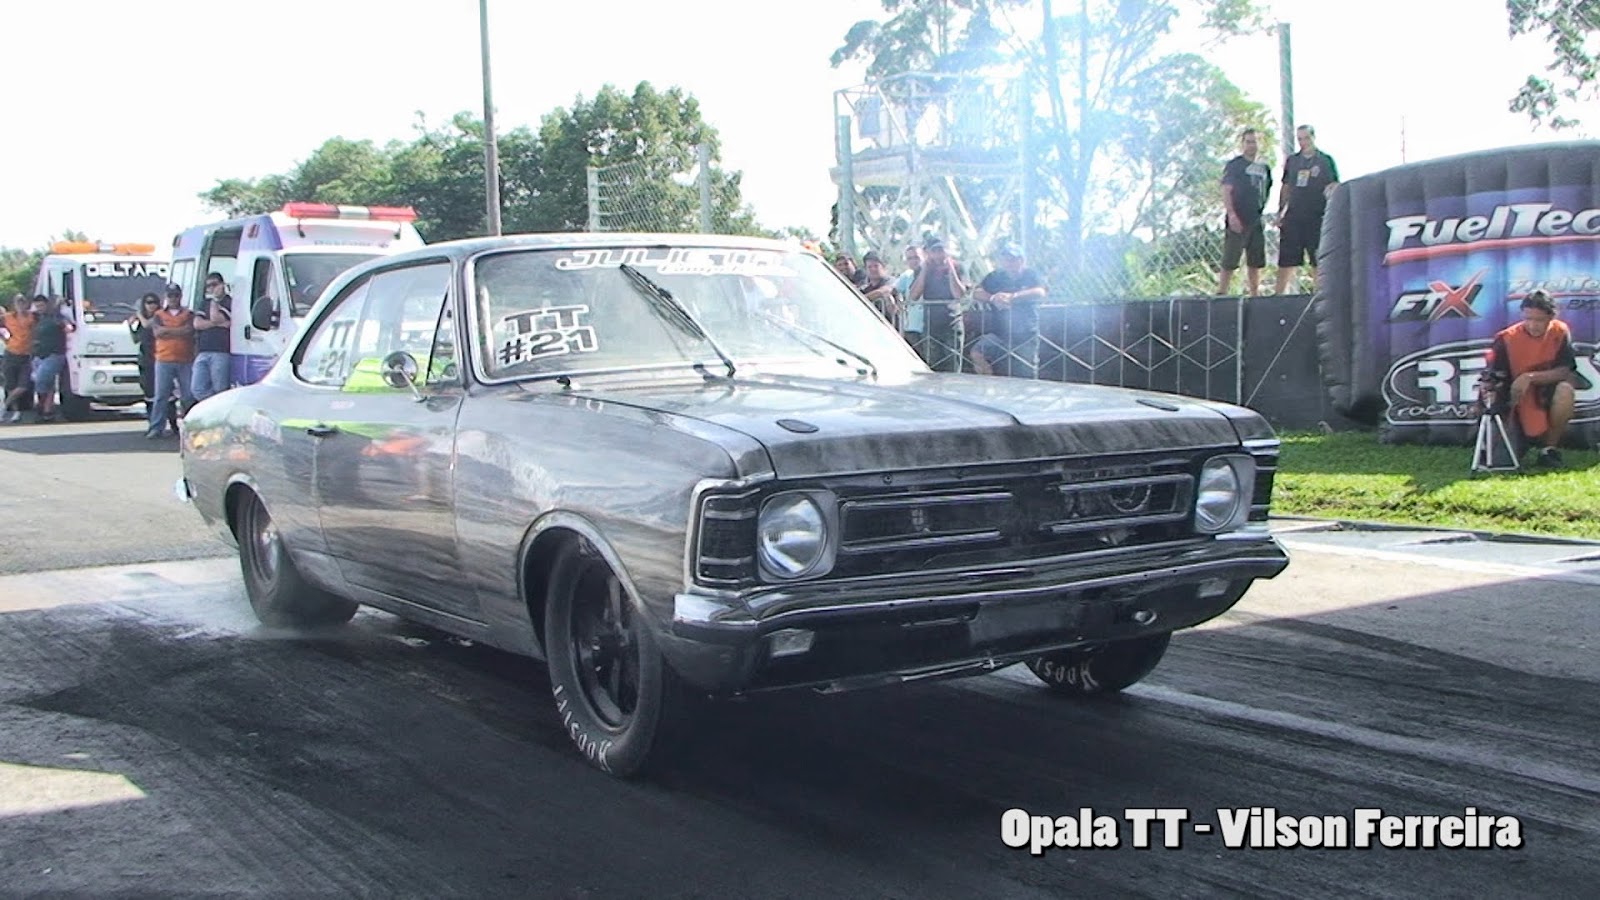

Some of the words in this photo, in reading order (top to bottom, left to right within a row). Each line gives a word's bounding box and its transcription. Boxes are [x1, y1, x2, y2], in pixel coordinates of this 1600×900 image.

[1385, 203, 1600, 250] FuelTec
[1389, 268, 1488, 321] FTX
[329, 320, 355, 348] TT
[503, 304, 589, 335] TT
[497, 326, 598, 365] #21
